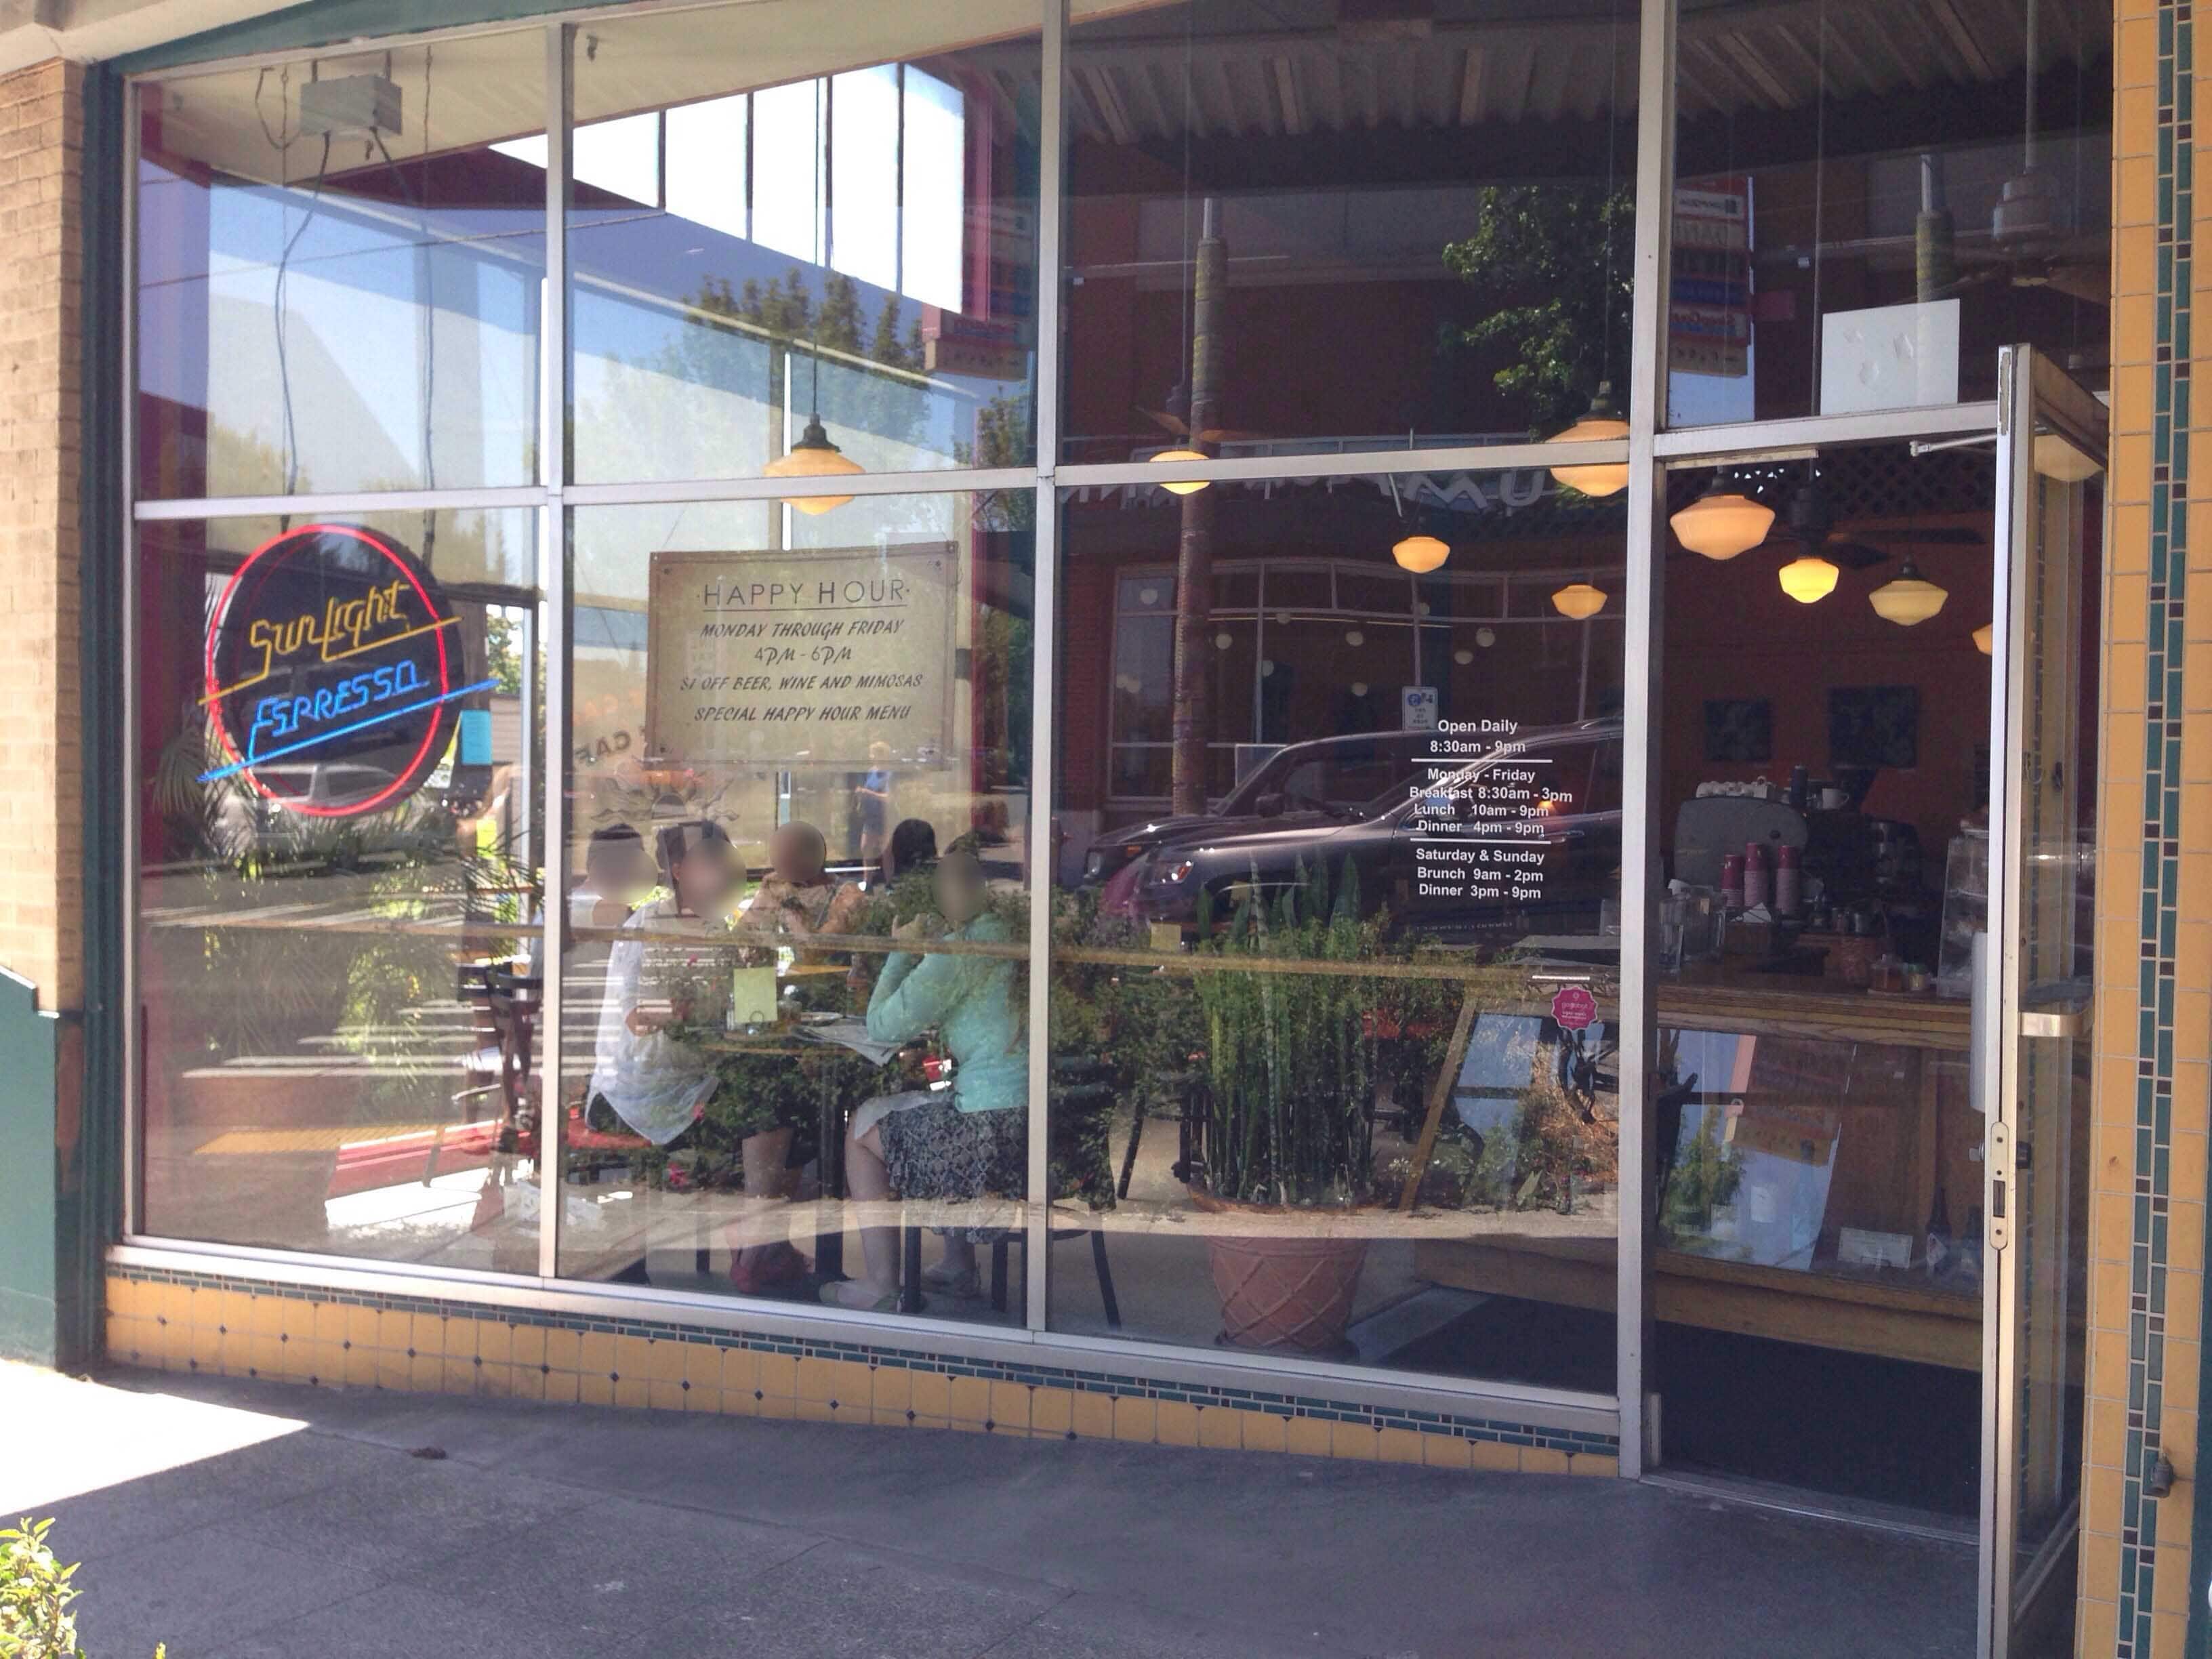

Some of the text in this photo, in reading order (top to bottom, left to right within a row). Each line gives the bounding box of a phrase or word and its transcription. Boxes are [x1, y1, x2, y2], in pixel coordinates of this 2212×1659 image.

[704, 579, 905, 606] HAPPY HOUR
[700, 619, 905, 640] MONDAY THROUGH FRIDAY
[701, 676, 731, 690] OFF
[733, 676, 771, 691] BEER,
[779, 675, 818, 690] WINE
[819, 676, 852, 690] AND
[855, 674, 923, 689] MIMOSAS
[249, 659, 430, 751] ESPRESSO
[694, 705, 912, 722] SPECIAL HAPPY HOUR MENU
[1438, 719, 1518, 735] Open Daily
[1430, 740, 1481, 752] 8:30am
[1494, 741, 1525, 755] 9pm
[1428, 769, 1480, 782] Monday
[1492, 769, 1536, 783] Friday
[1410, 787, 1473, 799] Breakfast
[1478, 787, 1530, 799] 8:30am
[1542, 787, 1572, 802] 3pm
[1414, 804, 1455, 815] Lunch
[1471, 804, 1507, 817] 10am
[1519, 805, 1549, 819] 9pm
[1418, 820, 1462, 832] Dinner
[1473, 821, 1502, 835] 4pm
[1515, 822, 1544, 836] 9pm
[1416, 848, 1544, 865] Saturday & Sunday
[1418, 867, 1465, 880] Brunch
[1473, 868, 1501, 880] 9am
[1514, 869, 1543, 884] 2pm
[1419, 884, 1463, 896] Dinner
[1471, 885, 1499, 899] 3pm
[1511, 886, 1541, 900] 9pm
